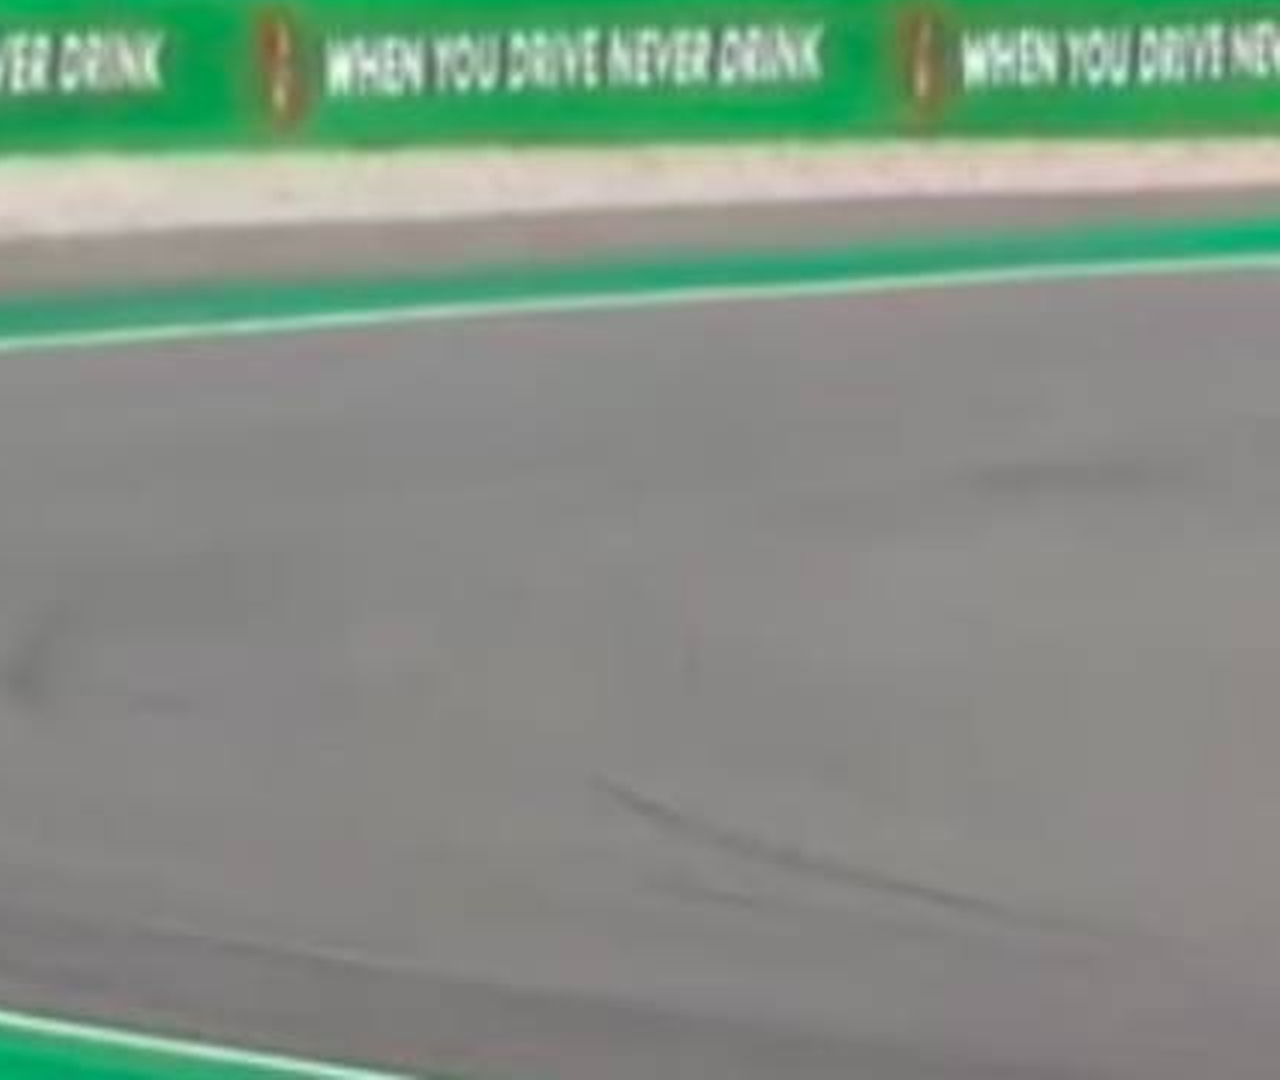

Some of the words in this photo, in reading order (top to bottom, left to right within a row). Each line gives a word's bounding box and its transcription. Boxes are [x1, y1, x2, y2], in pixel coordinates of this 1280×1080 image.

[58, 28, 164, 91] DRINK
[325, 35, 425, 97] WHEN
[434, 32, 501, 92] YOU
[507, 29, 602, 89] DRIVE
[608, 26, 712, 86] NEVER
[718, 24, 824, 84] DRINK
[961, 30, 1059, 90] WHEN
[1065, 26, 1131, 86] YOU
[1139, 22, 1224, 83] DRIVE
